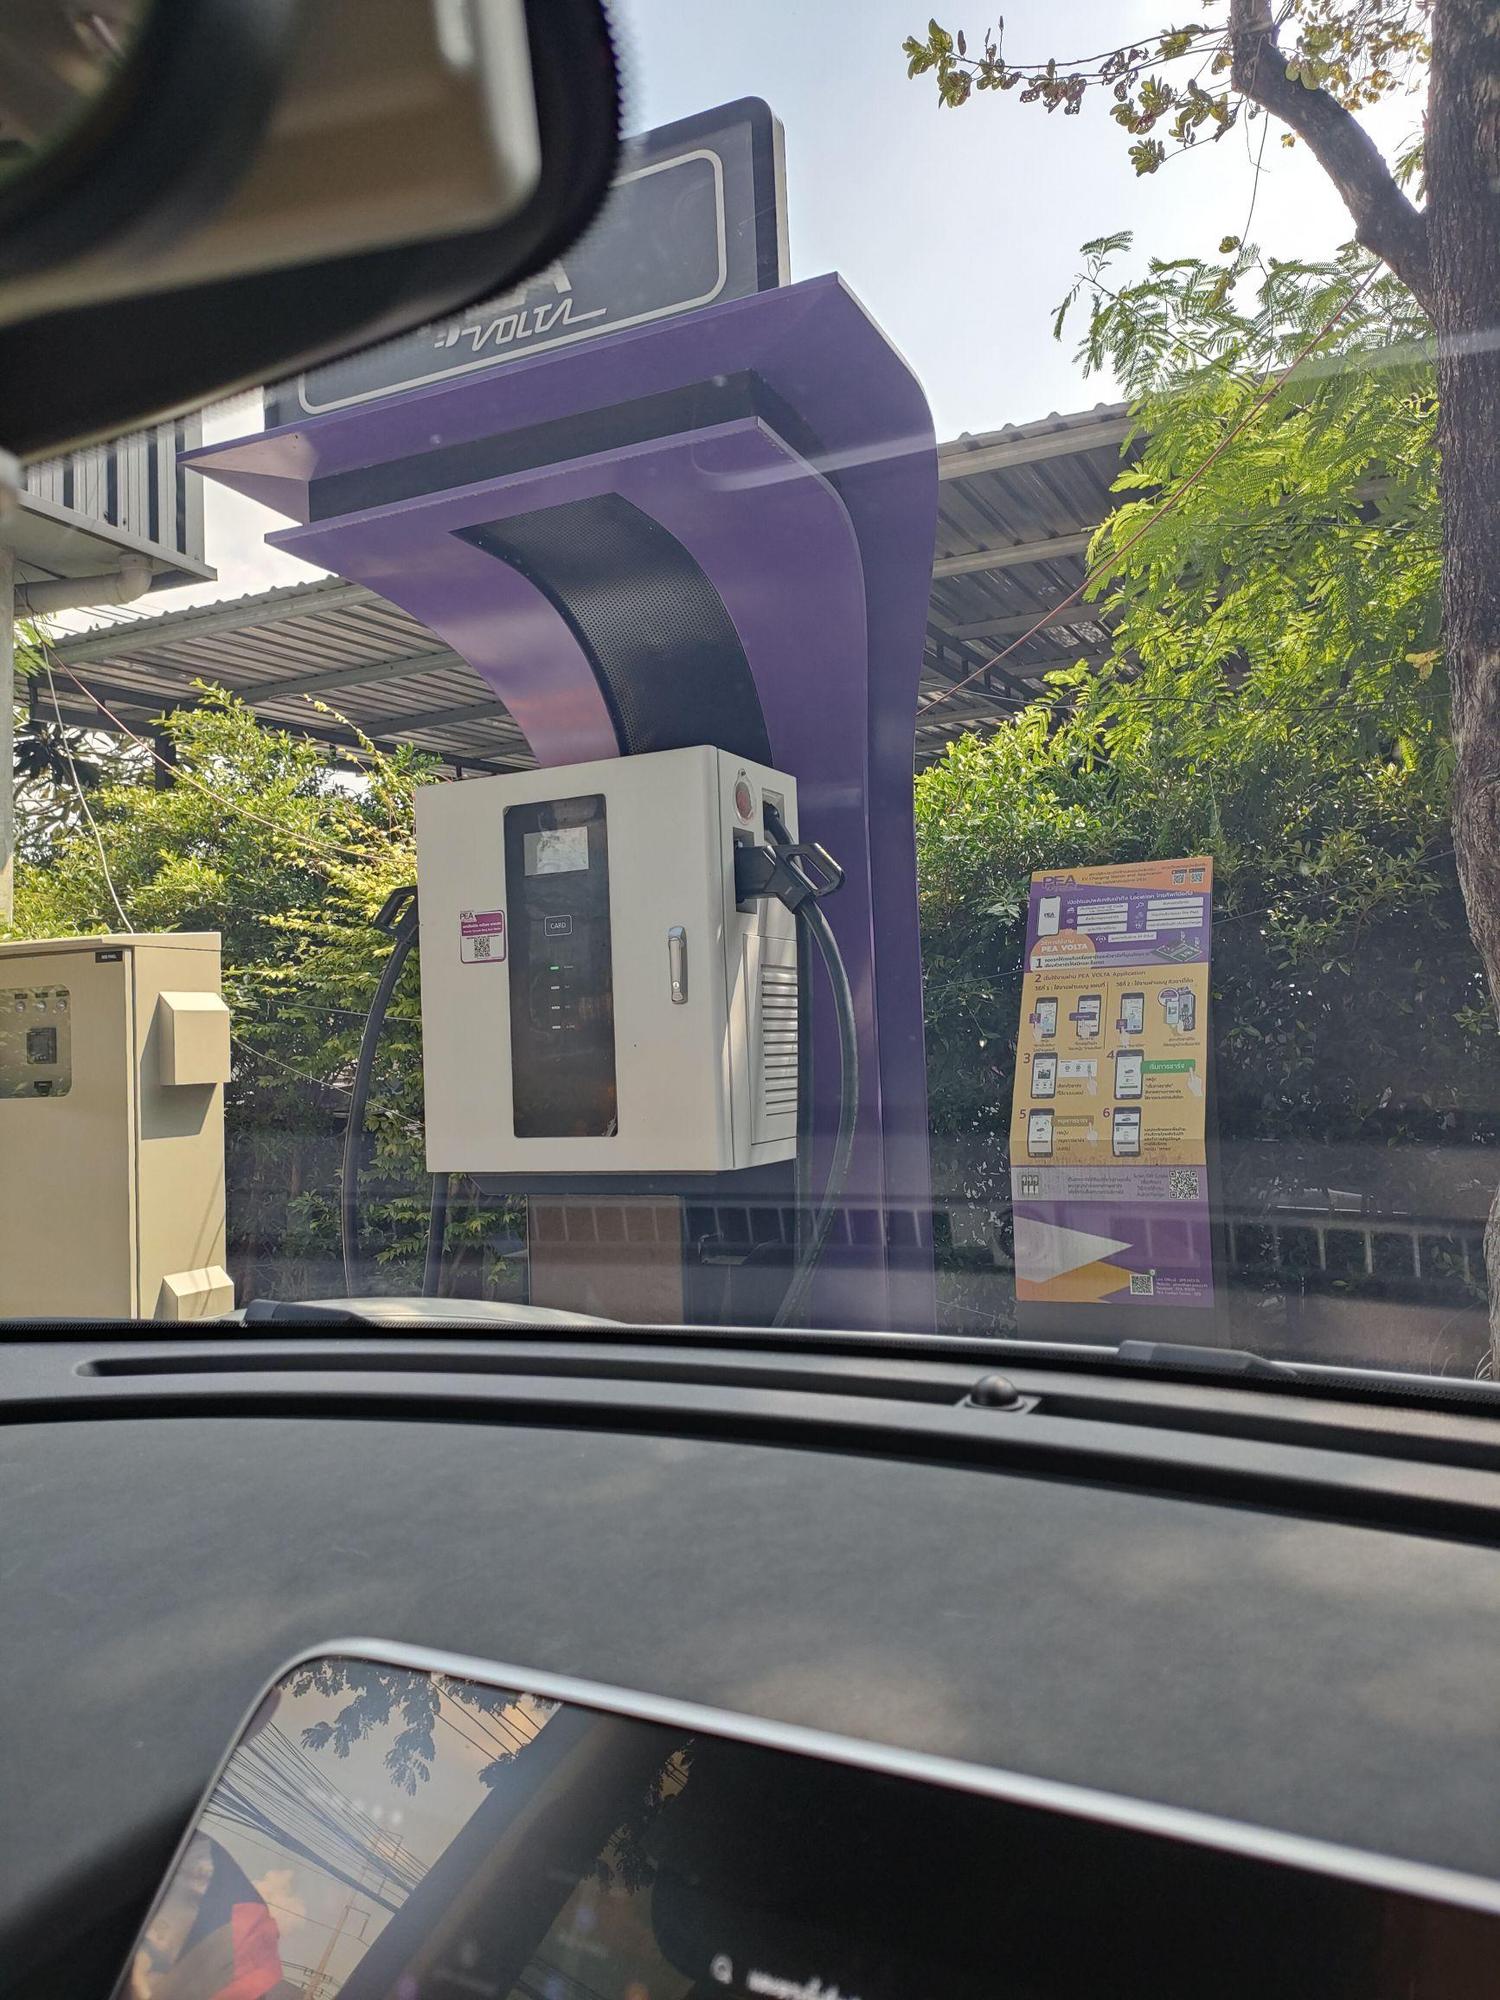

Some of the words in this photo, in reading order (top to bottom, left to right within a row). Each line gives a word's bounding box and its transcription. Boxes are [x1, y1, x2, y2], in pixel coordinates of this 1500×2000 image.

[461, 298, 607, 351] VOLTA
[1043, 875, 1077, 889] PEA
[1129, 893, 1155, 901] Location
[460, 911, 474, 920] PEA
[550, 921, 567, 930] CARD
[1041, 945, 1058, 953] PEA
[1061, 943, 1088, 951] VOLTA
[1035, 958, 1043, 968] 1
[1035, 974, 1042, 983] 2
[1112, 970, 1146, 978] Application
[1023, 1053, 1031, 1064] 3
[1106, 1050, 1115, 1060] 4
[1019, 1109, 1027, 1119] 5
[1103, 1108, 1111, 1118] 6
